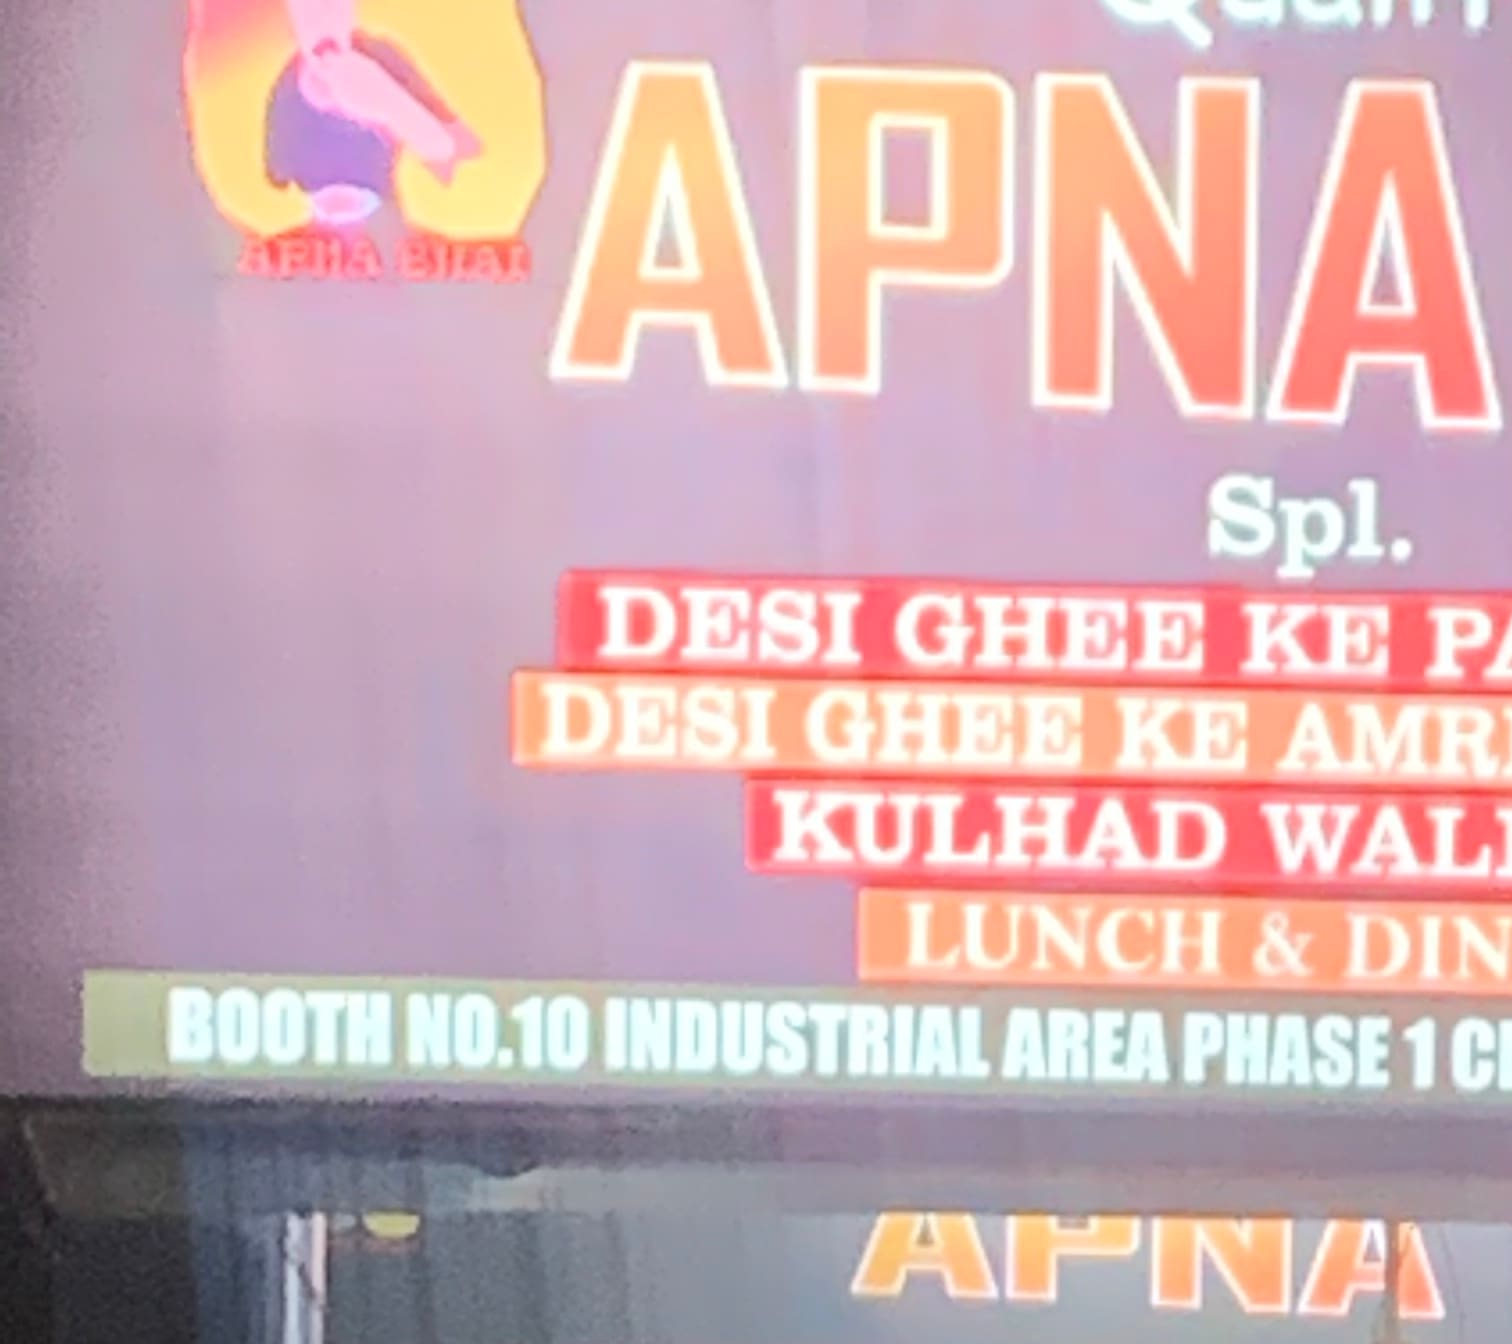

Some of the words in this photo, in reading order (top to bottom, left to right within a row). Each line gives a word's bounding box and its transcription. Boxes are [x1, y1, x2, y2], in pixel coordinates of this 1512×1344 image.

[549, 60, 1503, 430] APNA
[1209, 473, 1411, 577] Spl.
[600, 586, 862, 664] DESI
[895, 595, 1204, 671] GHEE
[1240, 604, 1389, 676] KE
[540, 682, 776, 760] DESI
[807, 689, 1083, 767] GHEE
[1116, 698, 1248, 770] KE
[772, 789, 1227, 871] KULHAD
[905, 902, 1224, 977] LUNCH
[1252, 911, 1311, 975] &
[166, 985, 393, 1066] BOOTH
[407, 992, 590, 1071] NO.10
[605, 996, 989, 1078] INDUSTRIAL
[1003, 1006, 1169, 1082] AREA
[1182, 1010, 1390, 1088] PHASE
[1403, 1015, 1436, 1089] 1
[851, 1212, 1445, 1319] APNA
